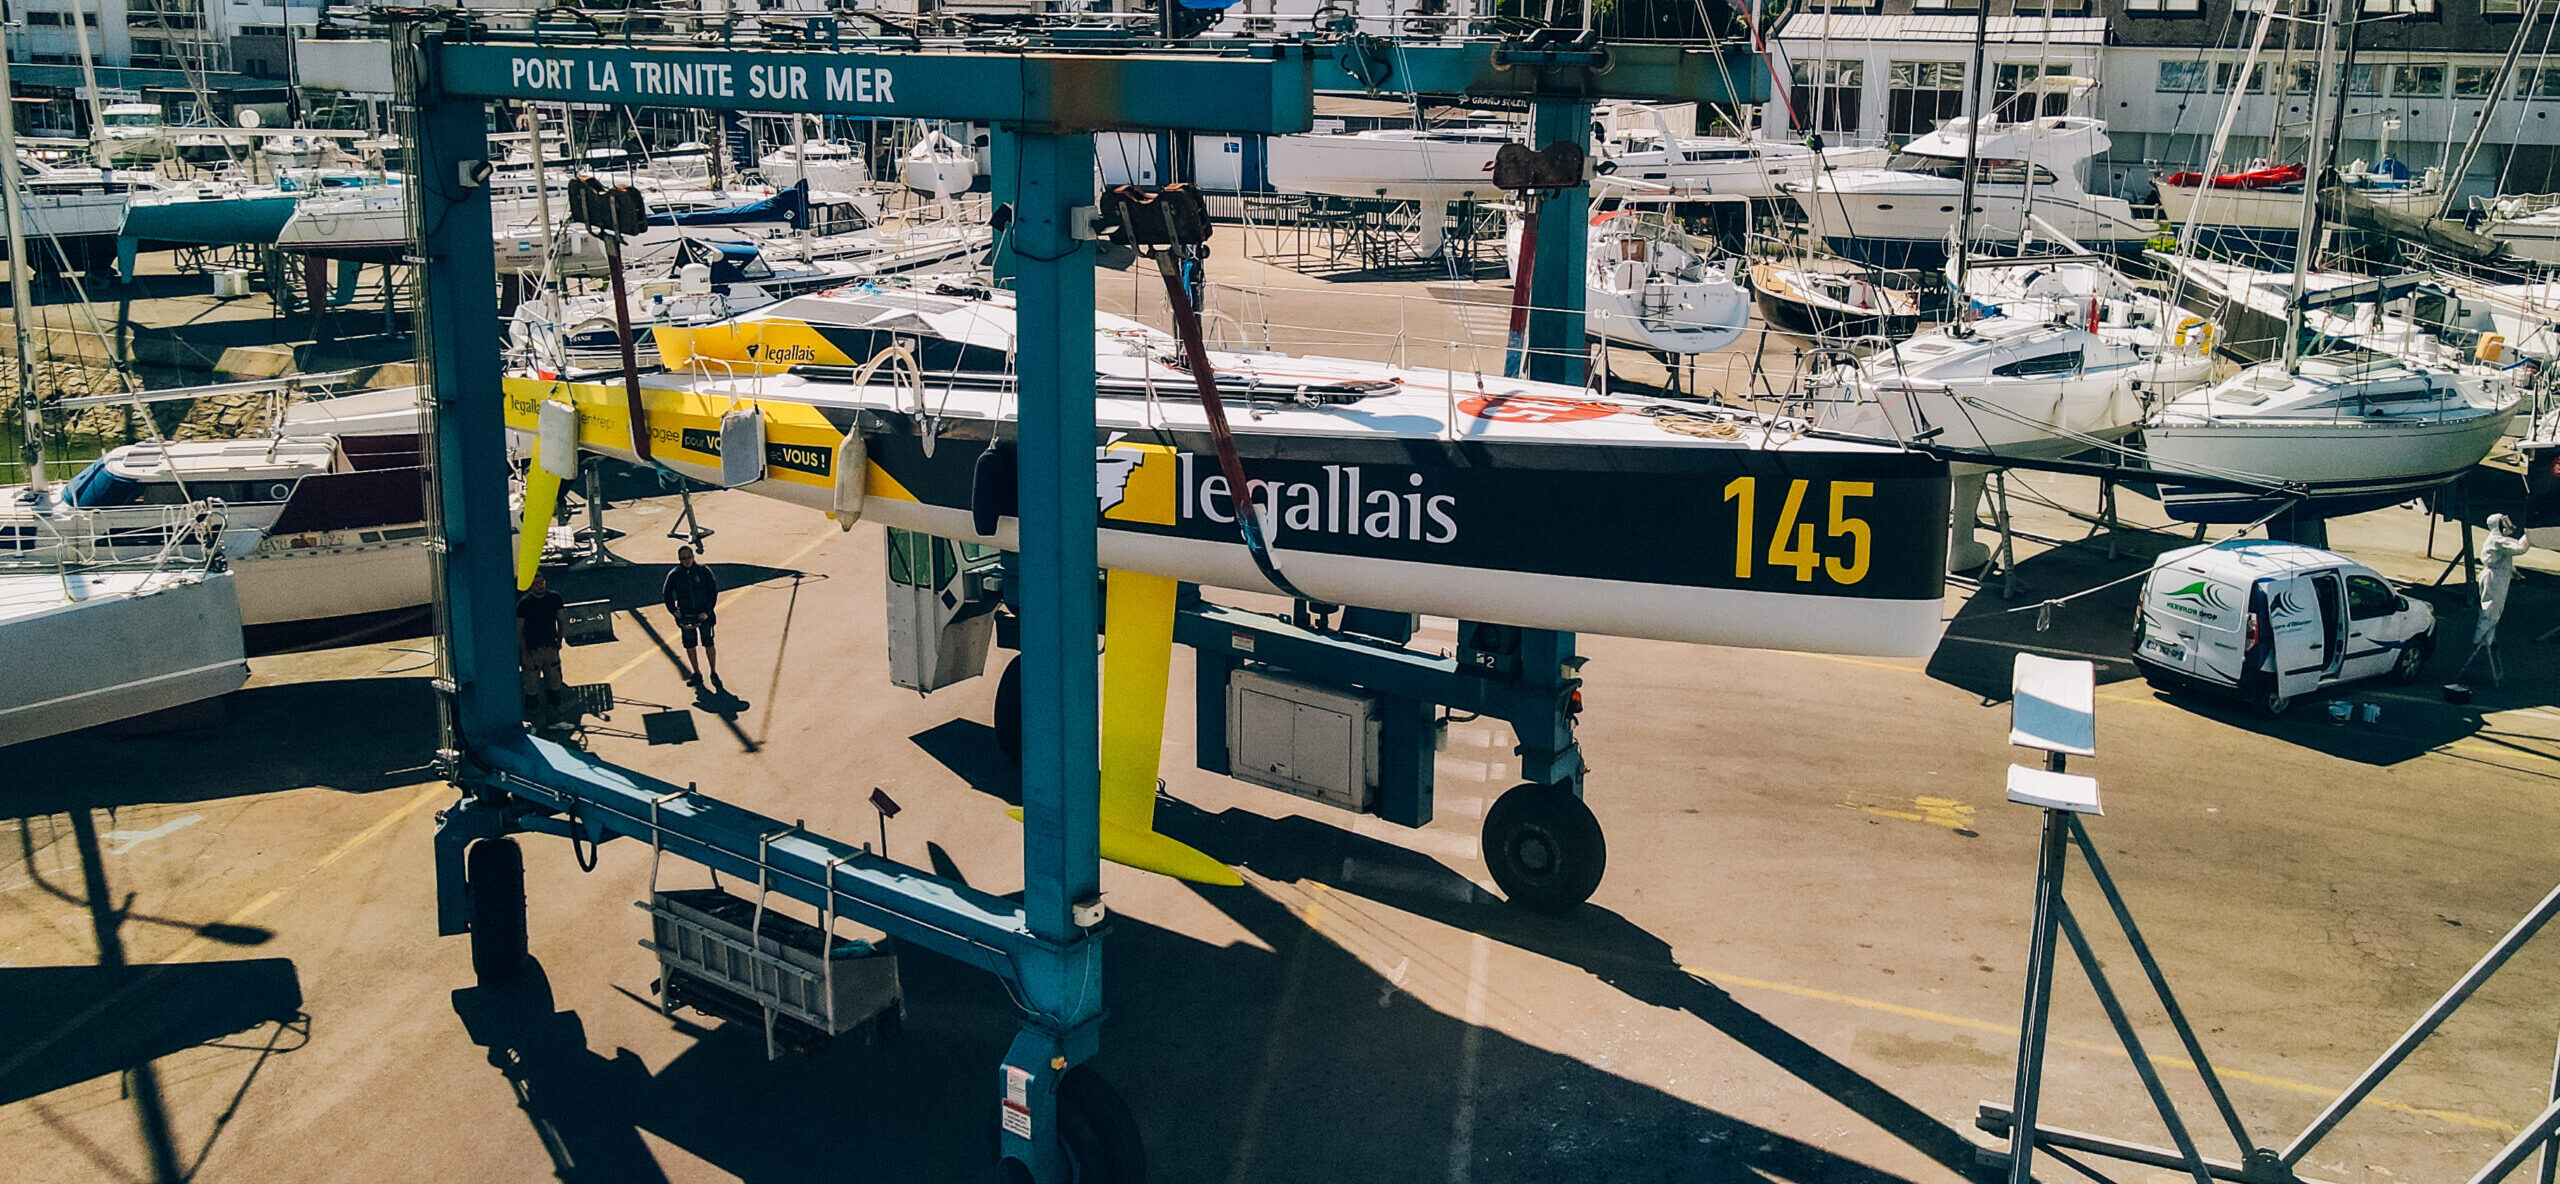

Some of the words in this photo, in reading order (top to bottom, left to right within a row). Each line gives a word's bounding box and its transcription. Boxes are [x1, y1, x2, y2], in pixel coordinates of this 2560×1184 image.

[512, 57, 574, 90] PORT
[587, 60, 619, 92] LA
[631, 62, 734, 97] TRINITE
[749, 65, 808, 100] SUR
[826, 67, 895, 103] MER
[765, 345, 815, 364] legallais
[511, 394, 541, 416] legalla
[706, 435, 721, 451] VO
[783, 447, 818, 467] VOUS
[1176, 452, 1457, 550] legallais
[1724, 476, 1874, 585] 145
[1486, 655, 1495, 669] 2
